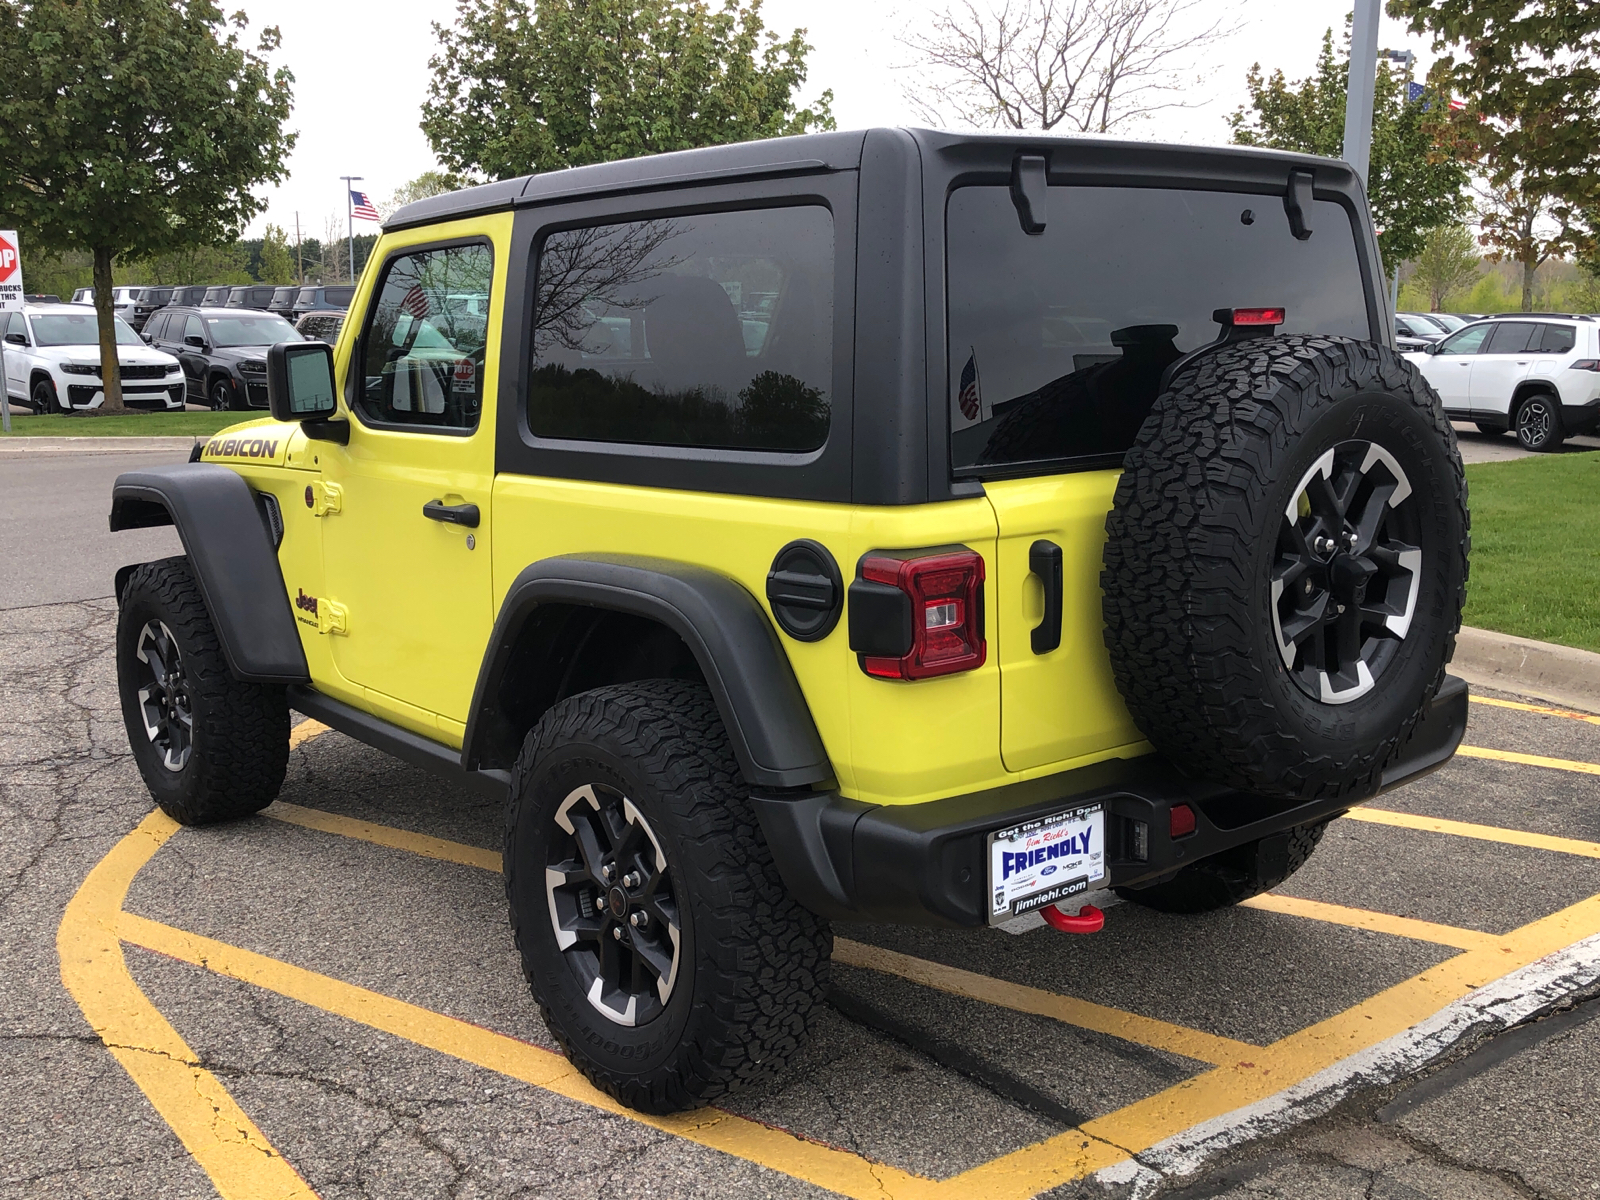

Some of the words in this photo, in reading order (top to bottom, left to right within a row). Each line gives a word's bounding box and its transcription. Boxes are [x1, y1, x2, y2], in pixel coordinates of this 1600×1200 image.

[204, 439, 279, 458] RUBICON
[998, 827, 1019, 839] Get
[1022, 821, 1042, 832] the
[1044, 811, 1073, 824] Riehl
[1076, 803, 1102, 815] Deal
[1002, 824, 1093, 881] FRIENDLY
[1025, 837, 1041, 851] Jim
[1042, 827, 1069, 843] Riehl's
[1062, 859, 1083, 871] MOKE
[1014, 881, 1087, 914] jimriehl.com
